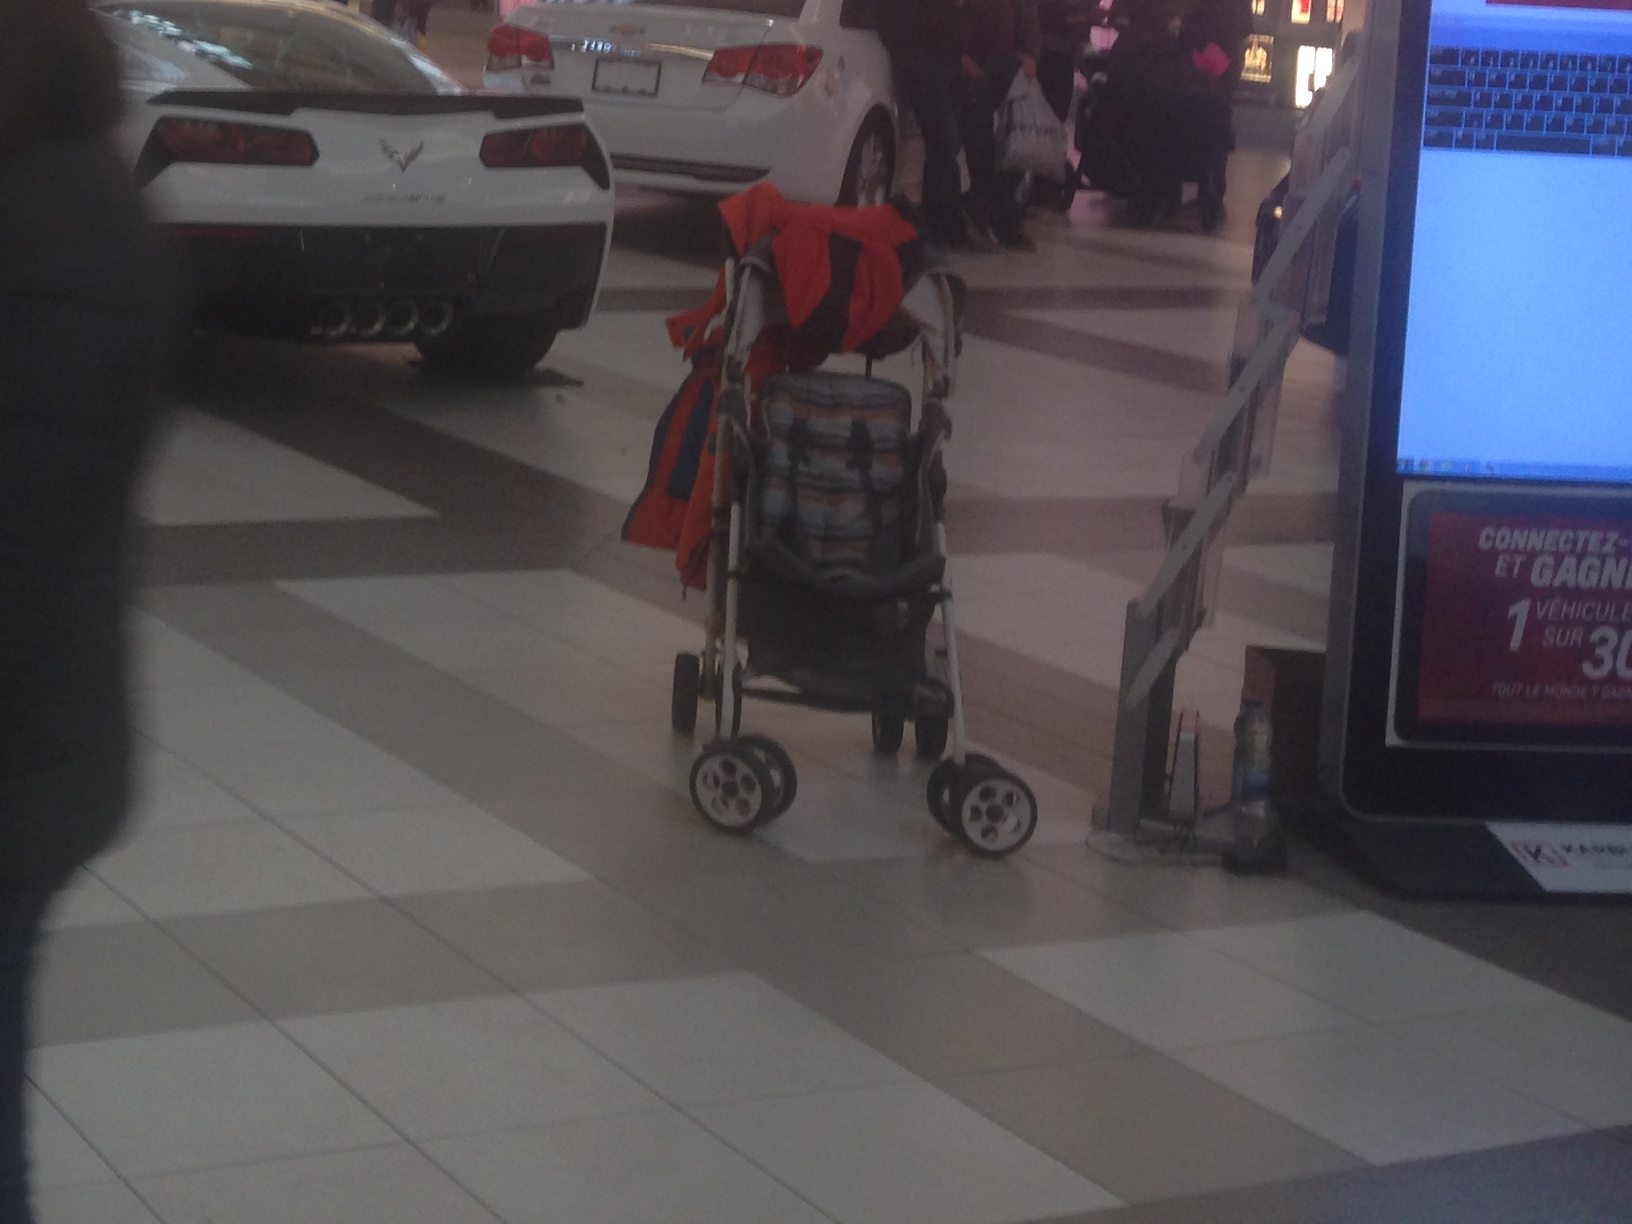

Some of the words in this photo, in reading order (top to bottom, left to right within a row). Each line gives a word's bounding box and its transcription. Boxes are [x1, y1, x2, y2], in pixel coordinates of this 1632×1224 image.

[1494, 553, 1527, 578] ET
[1507, 598, 1531, 652] 1
[1542, 626, 1584, 648] SUR
